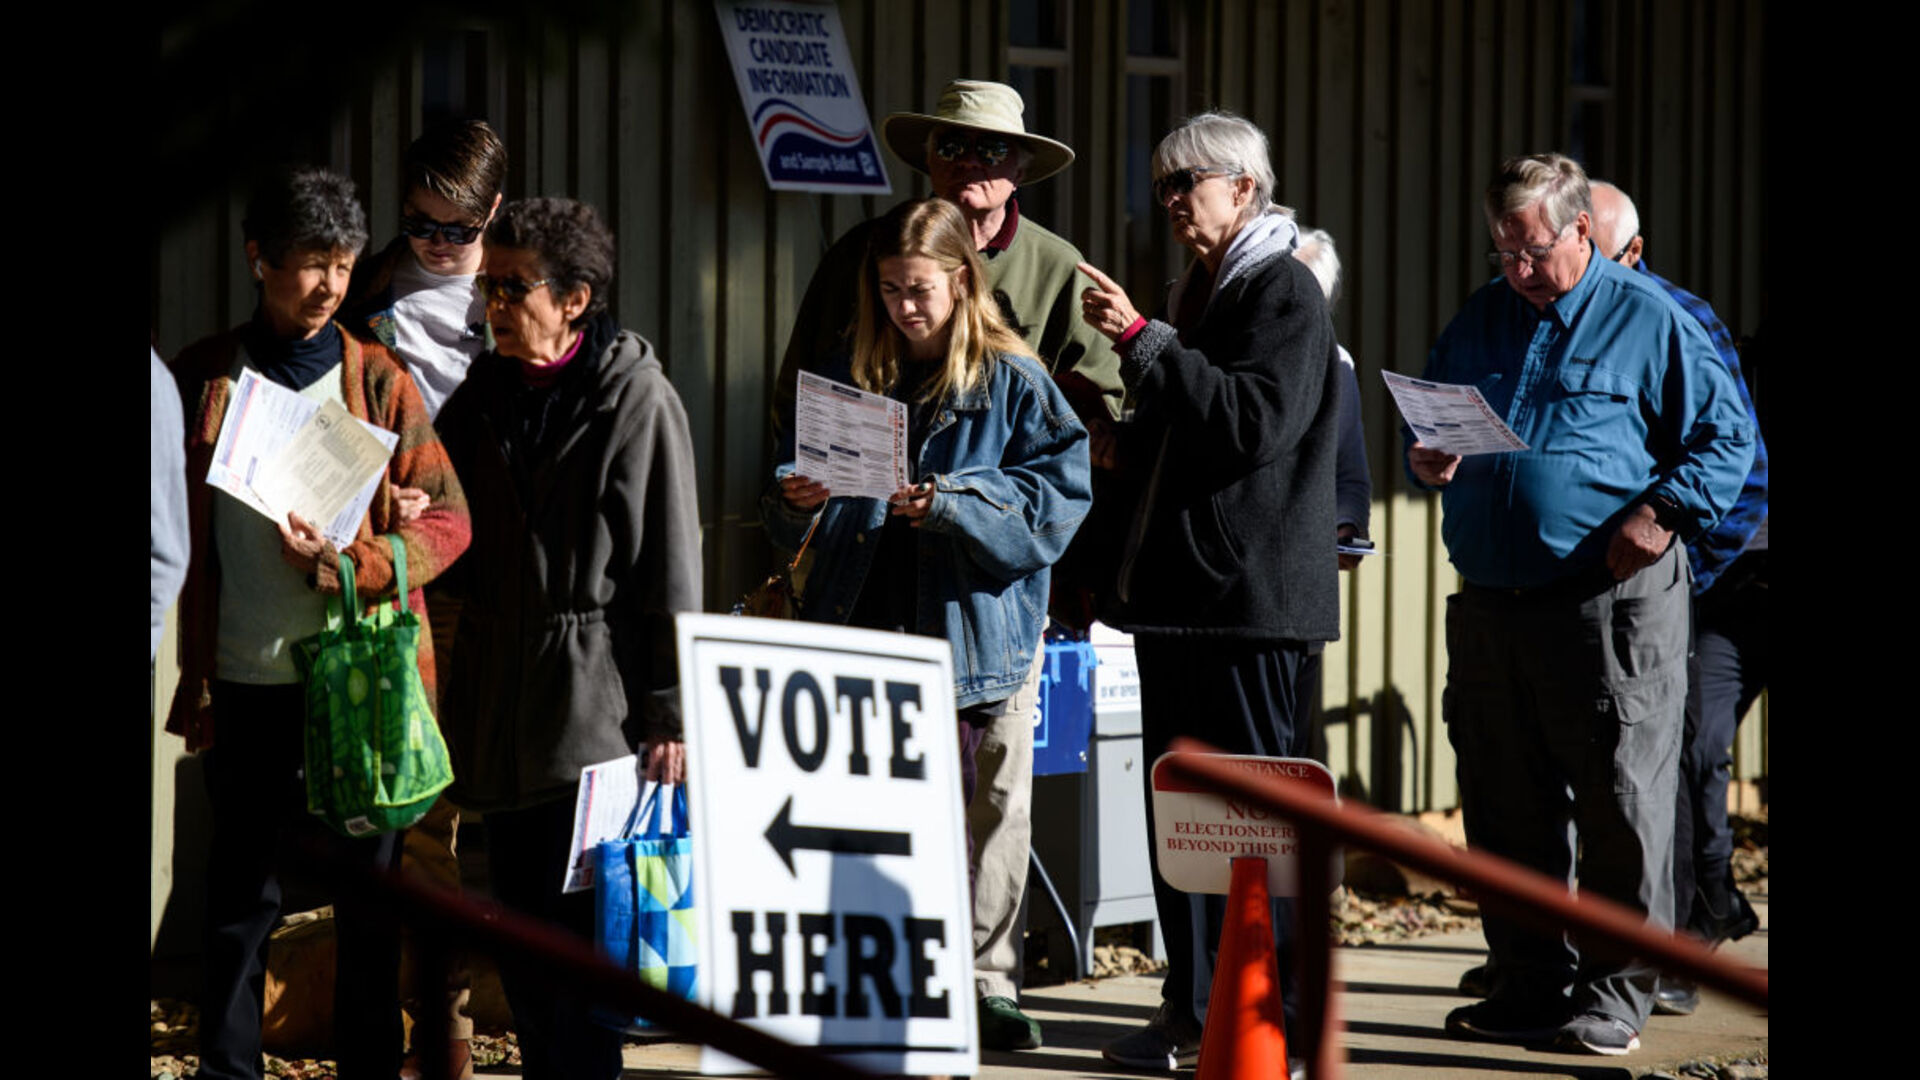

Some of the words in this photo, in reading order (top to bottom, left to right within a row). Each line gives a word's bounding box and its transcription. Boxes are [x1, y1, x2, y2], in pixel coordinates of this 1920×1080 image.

[734, 7, 830, 38] DEMOCRATIC
[749, 38, 833, 68] CANDIDATE
[747, 68, 851, 98] INFORMATION
[718, 666, 927, 780] VOTE
[1167, 838, 1235, 854] BEYOND
[1237, 841, 1277, 854] THIS
[730, 911, 950, 1019] HERE
